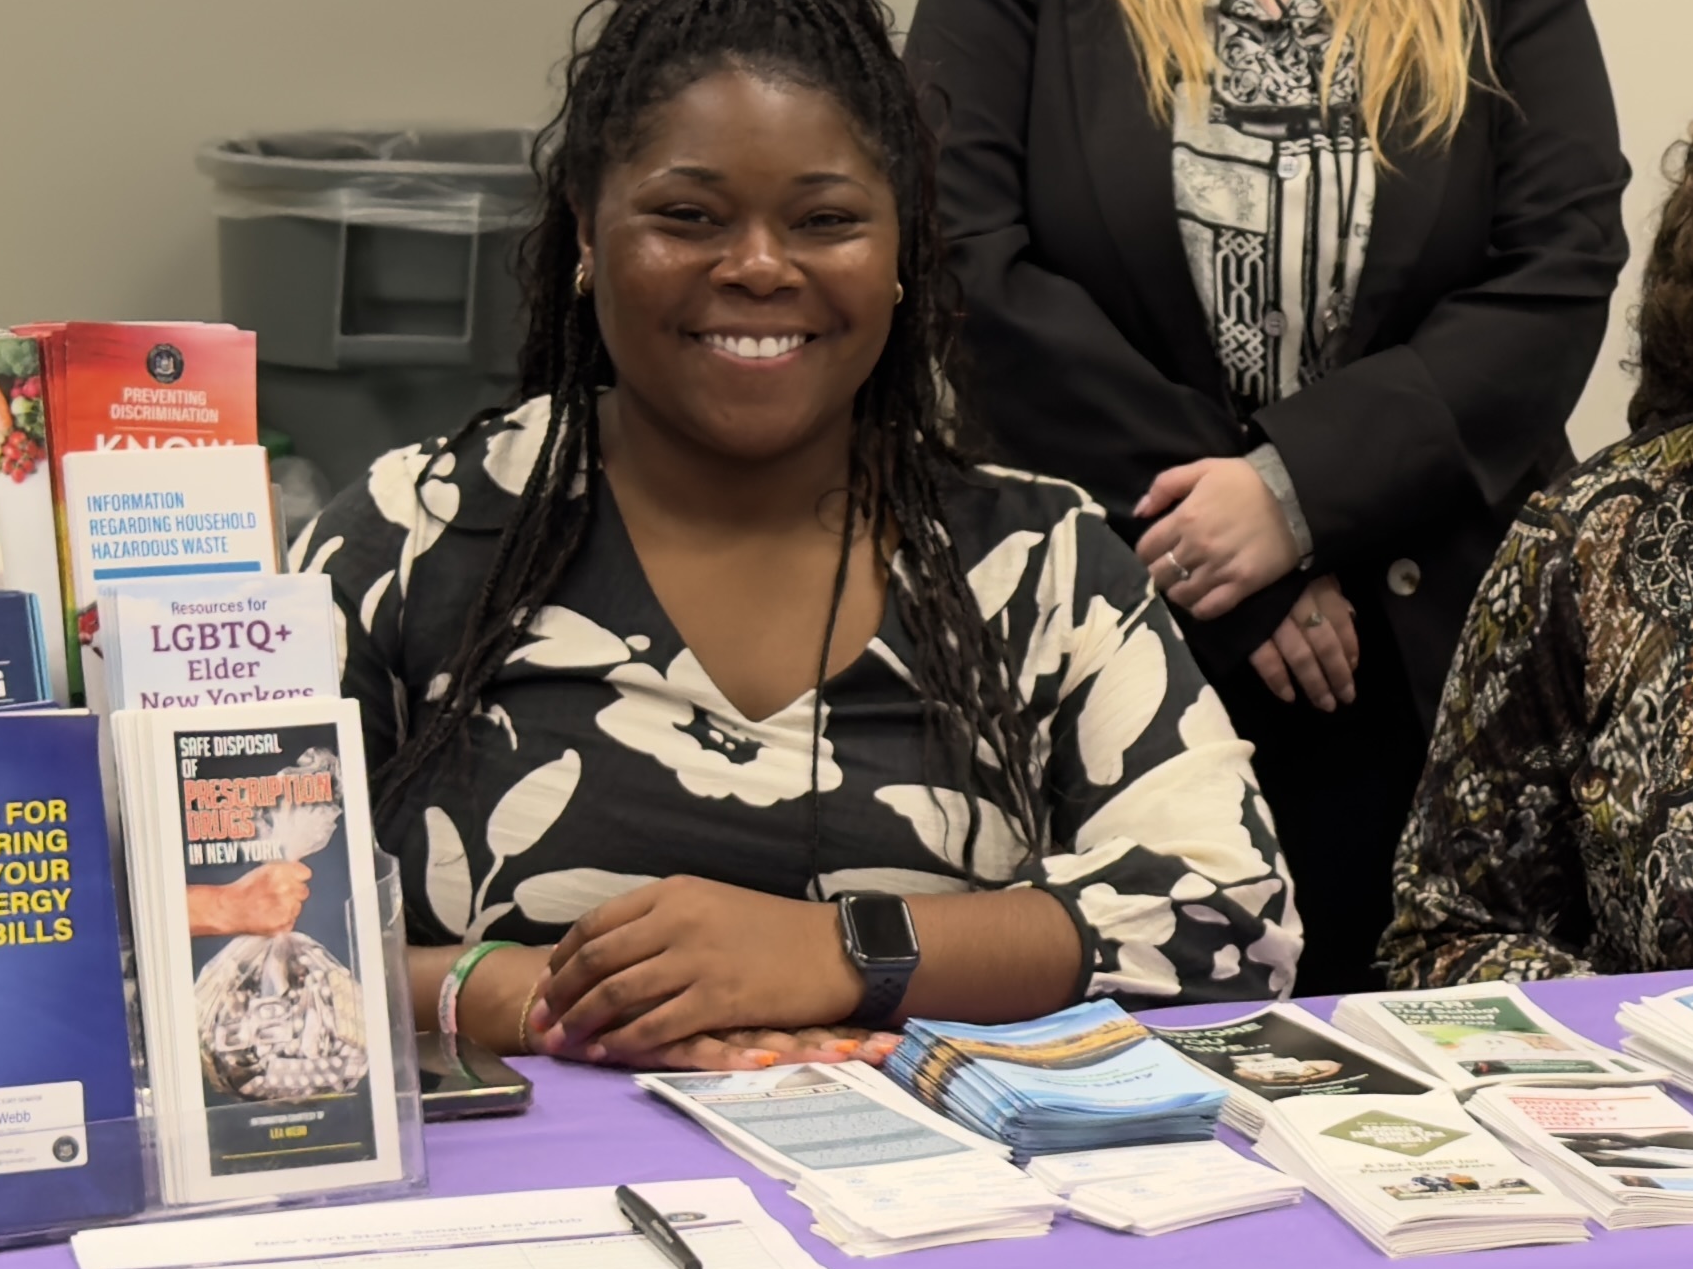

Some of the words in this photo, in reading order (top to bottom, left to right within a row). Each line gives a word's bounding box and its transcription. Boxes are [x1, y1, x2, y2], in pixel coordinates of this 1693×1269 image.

[123, 387, 207, 406] PREVENTING
[110, 404, 219, 423] DISCRIMINATION
[87, 492, 184, 512] INFORMATION
[89, 516, 172, 536] REGARDING
[176, 512, 256, 531] HOUSEHOLD
[91, 538, 179, 559] HAZARDOUS
[182, 536, 228, 554] WASTE
[171, 600, 244, 616] Resources
[247, 598, 268, 612] for
[150, 620, 292, 653] LGBTQ+
[188, 657, 260, 681] Elder
[140, 692, 200, 709] New
[206, 685, 314, 706] Yorkers
[179, 737, 211, 757] SAFE
[213, 734, 282, 756] DISPOSAL
[182, 759, 198, 778] OF
[183, 771, 332, 810] PRESCRIPTION
[6, 799, 67, 825] FOR
[186, 809, 255, 841] DRUGS
[189, 844, 203, 865] IN
[207, 842, 237, 864] NEW
[240, 841, 283, 861] YORK
